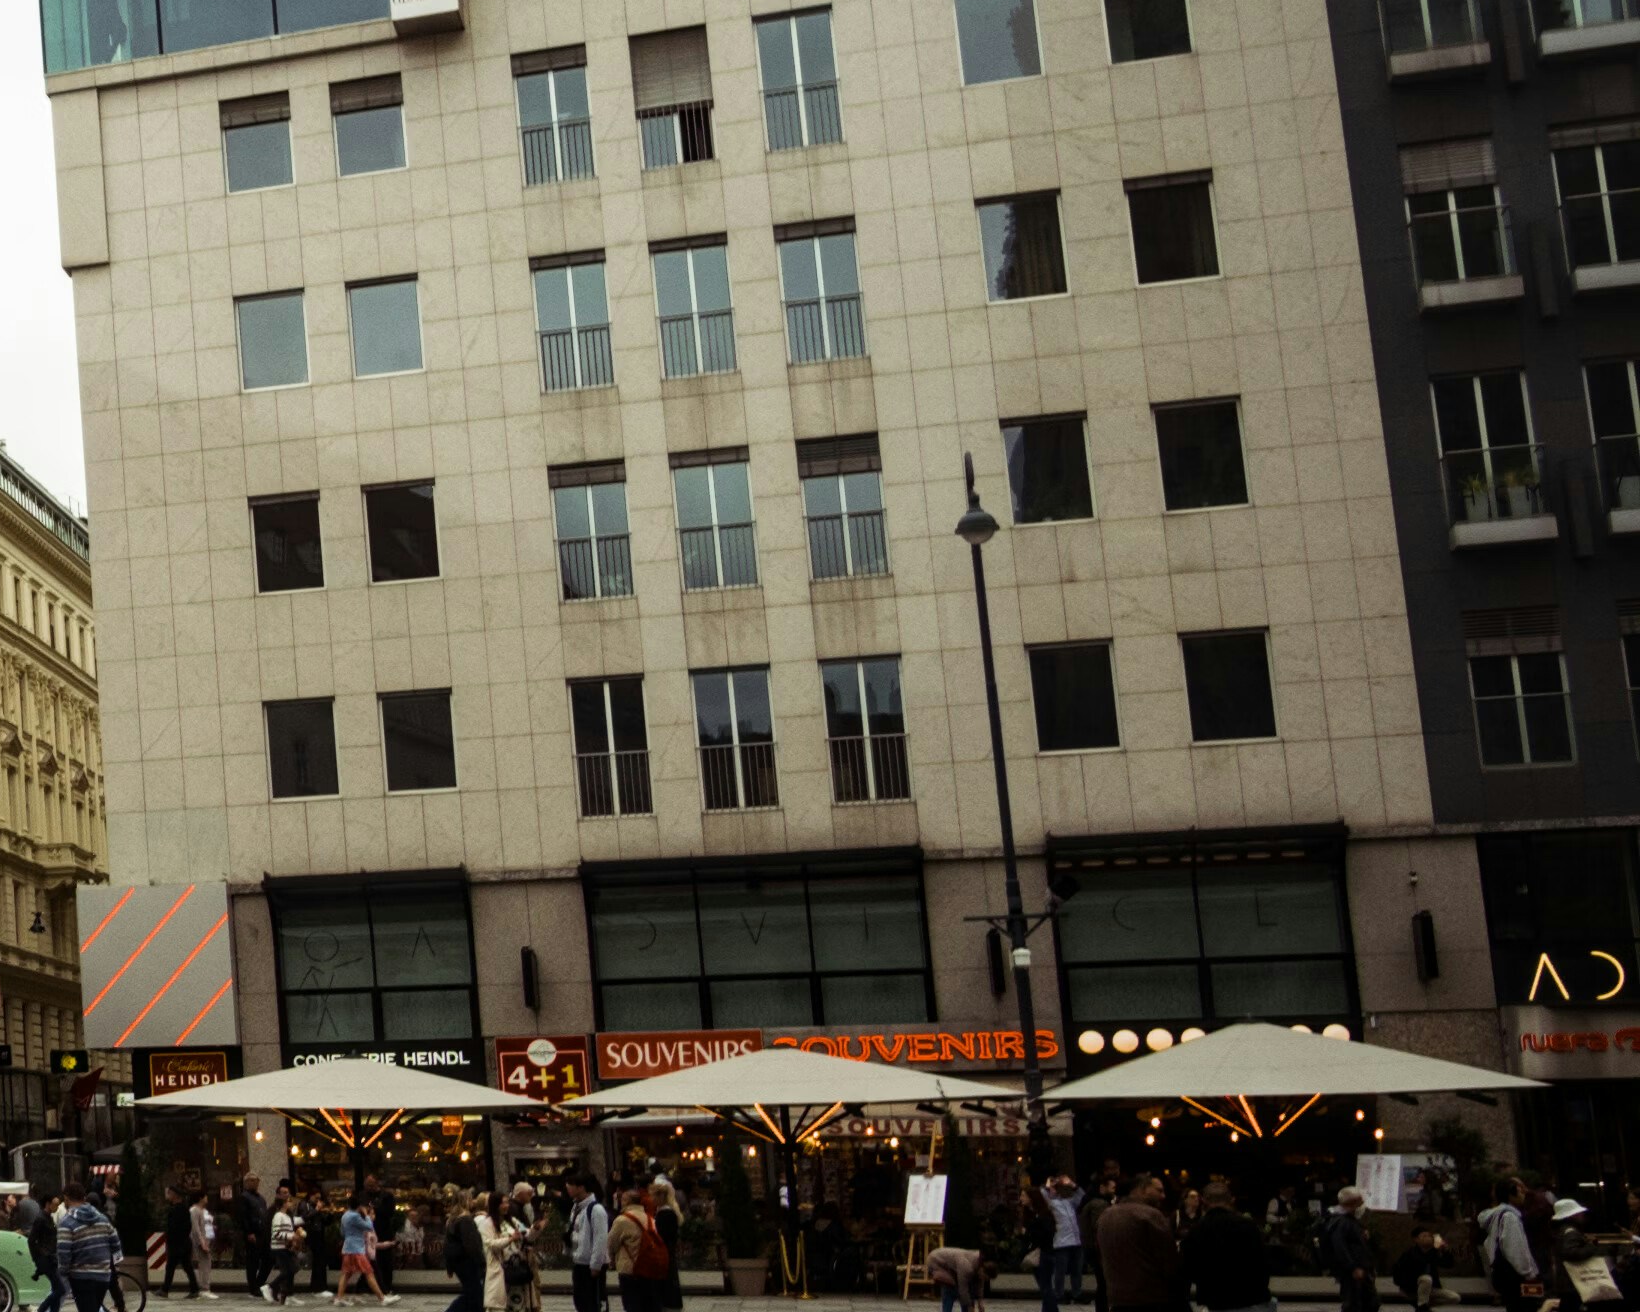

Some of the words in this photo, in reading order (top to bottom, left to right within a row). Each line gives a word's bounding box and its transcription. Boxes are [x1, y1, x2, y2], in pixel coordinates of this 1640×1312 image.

[404, 1050, 471, 1067] HEINDL
[606, 1039, 754, 1069] SOUVENIRS
[773, 1030, 1059, 1063] OUVENIRS
